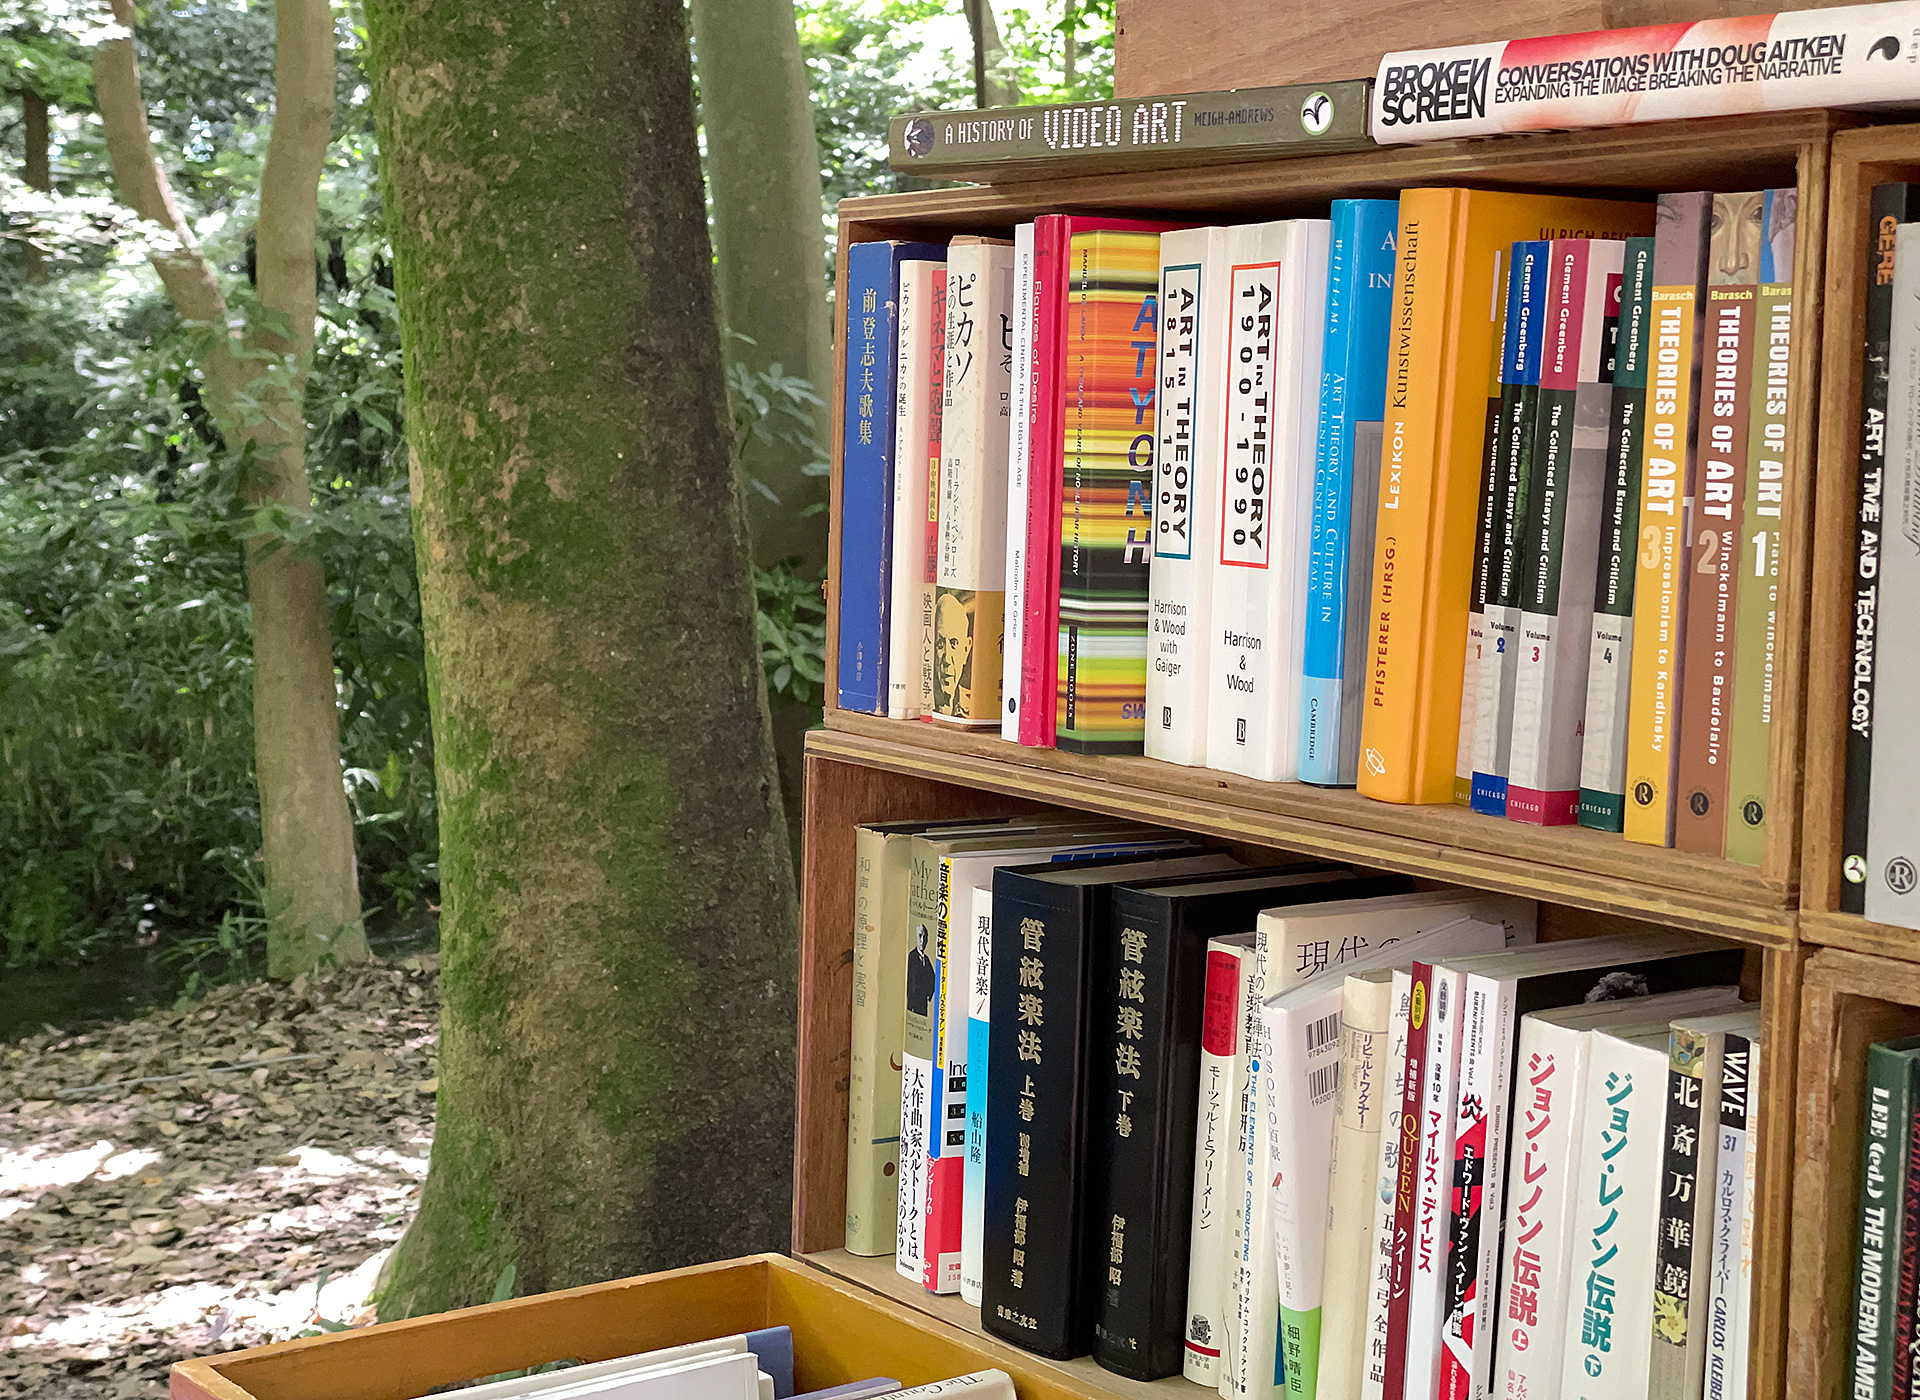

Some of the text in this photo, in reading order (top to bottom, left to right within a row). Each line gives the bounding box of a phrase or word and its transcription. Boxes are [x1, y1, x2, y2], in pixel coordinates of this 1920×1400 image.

[1384, 57, 1492, 96] BROKEN
[1494, 56, 1842, 103] EXPANDING THE IMAGE BREAKING THE NARRATIVE
[1496, 34, 1846, 87] CONVERSATIONS WITH DOUG AITKEN
[944, 101, 1275, 150] A HISTORY OF VIDEO ART MEIGH-ANDREWS
[1381, 84, 1486, 126] SCREEN
[1020, 253, 1029, 335] EXPERIMENTAL
[1331, 239, 1343, 335] WILLIAMS
[1516, 254, 1534, 371] Clement Greenberg
[1554, 254, 1574, 374] Clement Greenberg
[1626, 250, 1647, 371] Clement Greenberg
[1652, 290, 1693, 301] Barasch
[1711, 290, 1753, 301] Barasch
[955, 273, 977, 387] ピカソ
[1031, 280, 1042, 424] Figures of Desire
[857, 287, 877, 445] 前登志夫歌集
[1385, 221, 1420, 510] LEXIKON Kunstwissenschaft
[1016, 421, 1024, 464] DIGITAL
[1160, 289, 1177, 533] 1815-1900
[1173, 287, 1194, 540] ART THEORY
[1233, 285, 1255, 545] 1900-1990
[1250, 282, 1272, 550] ART THEORY
[1646, 306, 1682, 516] THEORIES OF ART
[1704, 305, 1741, 521] THEORIES OF ART
[1756, 302, 1792, 521] THEORIES OF ART
[1861, 408, 1885, 461] ART,
[1073, 472, 1082, 531] NONLINEAR
[1311, 373, 1330, 594] SIXTEENTH-CENTURY ITALY
[1321, 373, 1345, 623] ART THEORY, AND CULTURE IN
[1500, 401, 1523, 597] The Collected Essays and Criticism
[1536, 404, 1562, 604] The Collected Essays and Criticism
[1607, 402, 1634, 605] The Collected Essays and Criticism
[1013, 550, 1021, 591] Malcolm
[1071, 535, 1080, 576] HISTORY
[1640, 525, 1662, 570] 3
[1696, 530, 1719, 575] 2
[1751, 531, 1767, 577] 1
[1859, 529, 1879, 579] AND
[1154, 599, 1187, 616] Harrison
[1479, 556, 1489, 604] Criticism
[922, 592, 932, 698] 映画人と戦争
[1153, 618, 1186, 636] & Wood
[1160, 639, 1178, 654] with
[1223, 629, 1261, 650] Harrison
[1374, 536, 1397, 707] PFISTERER (HRSG.)
[1490, 621, 1515, 633] Volume
[1496, 637, 1505, 653] 2
[1525, 630, 1550, 641] Volume
[1596, 631, 1622, 642] Volume
[1651, 526, 1676, 752] Impressionism to Kandinsky
[1708, 531, 1733, 765] Winckelmann to Baudelaire
[1762, 531, 1780, 723] Plato to Winckelmann
[1155, 657, 1181, 678] Gaiger
[1226, 673, 1254, 694] Wood
[1239, 655, 1246, 670] &
[1532, 646, 1540, 662] 3
[1603, 647, 1612, 664] 4
[1851, 585, 1876, 738] TECHNOLOGY
[1067, 675, 1075, 718] BOOKS
[1308, 697, 1318, 761] CAMBRIDGE
[1477, 788, 1506, 801] CHICAGO
[1510, 799, 1540, 813] CHICAGO
[1581, 803, 1612, 815] CHICAGO
[912, 858, 932, 887] My
[1018, 916, 1045, 1122] 管絃楽法 上巻
[1116, 927, 1148, 1138] 管絃楽法 下巻
[1469, 1020, 1477, 1057] PRESENTS
[1461, 1090, 1483, 1124] 炎
[1721, 1052, 1748, 1117] WAVE
[970, 1111, 982, 1164] 船山隆
[1247, 1101, 1256, 1166] ELEMENTS
[1398, 1114, 1419, 1214] QUEEN
[1723, 1135, 1737, 1153] 31
[1246, 1170, 1253, 1186] OF
[1418, 1110, 1441, 1274] マイルス・デイビス
[1509, 1052, 1556, 1327] ジョン・レノン伝説
[1663, 1076, 1699, 1298] 北斎万華鏡
[1243, 1190, 1252, 1261] CONDUCTING
[1581, 1071, 1633, 1353] ジョン・レノン伝説
[1715, 1169, 1735, 1294] カルロス・クライバー
[1858, 1086, 1890, 1346] LEE (ed.) THE MODERN
[1392, 1226, 1408, 1299] クイーン
[1370, 1213, 1395, 1383] 五輪真弓全作品
[1711, 1297, 1727, 1351] CARLOS
[1287, 1325, 1303, 1393] 細野晴臣
